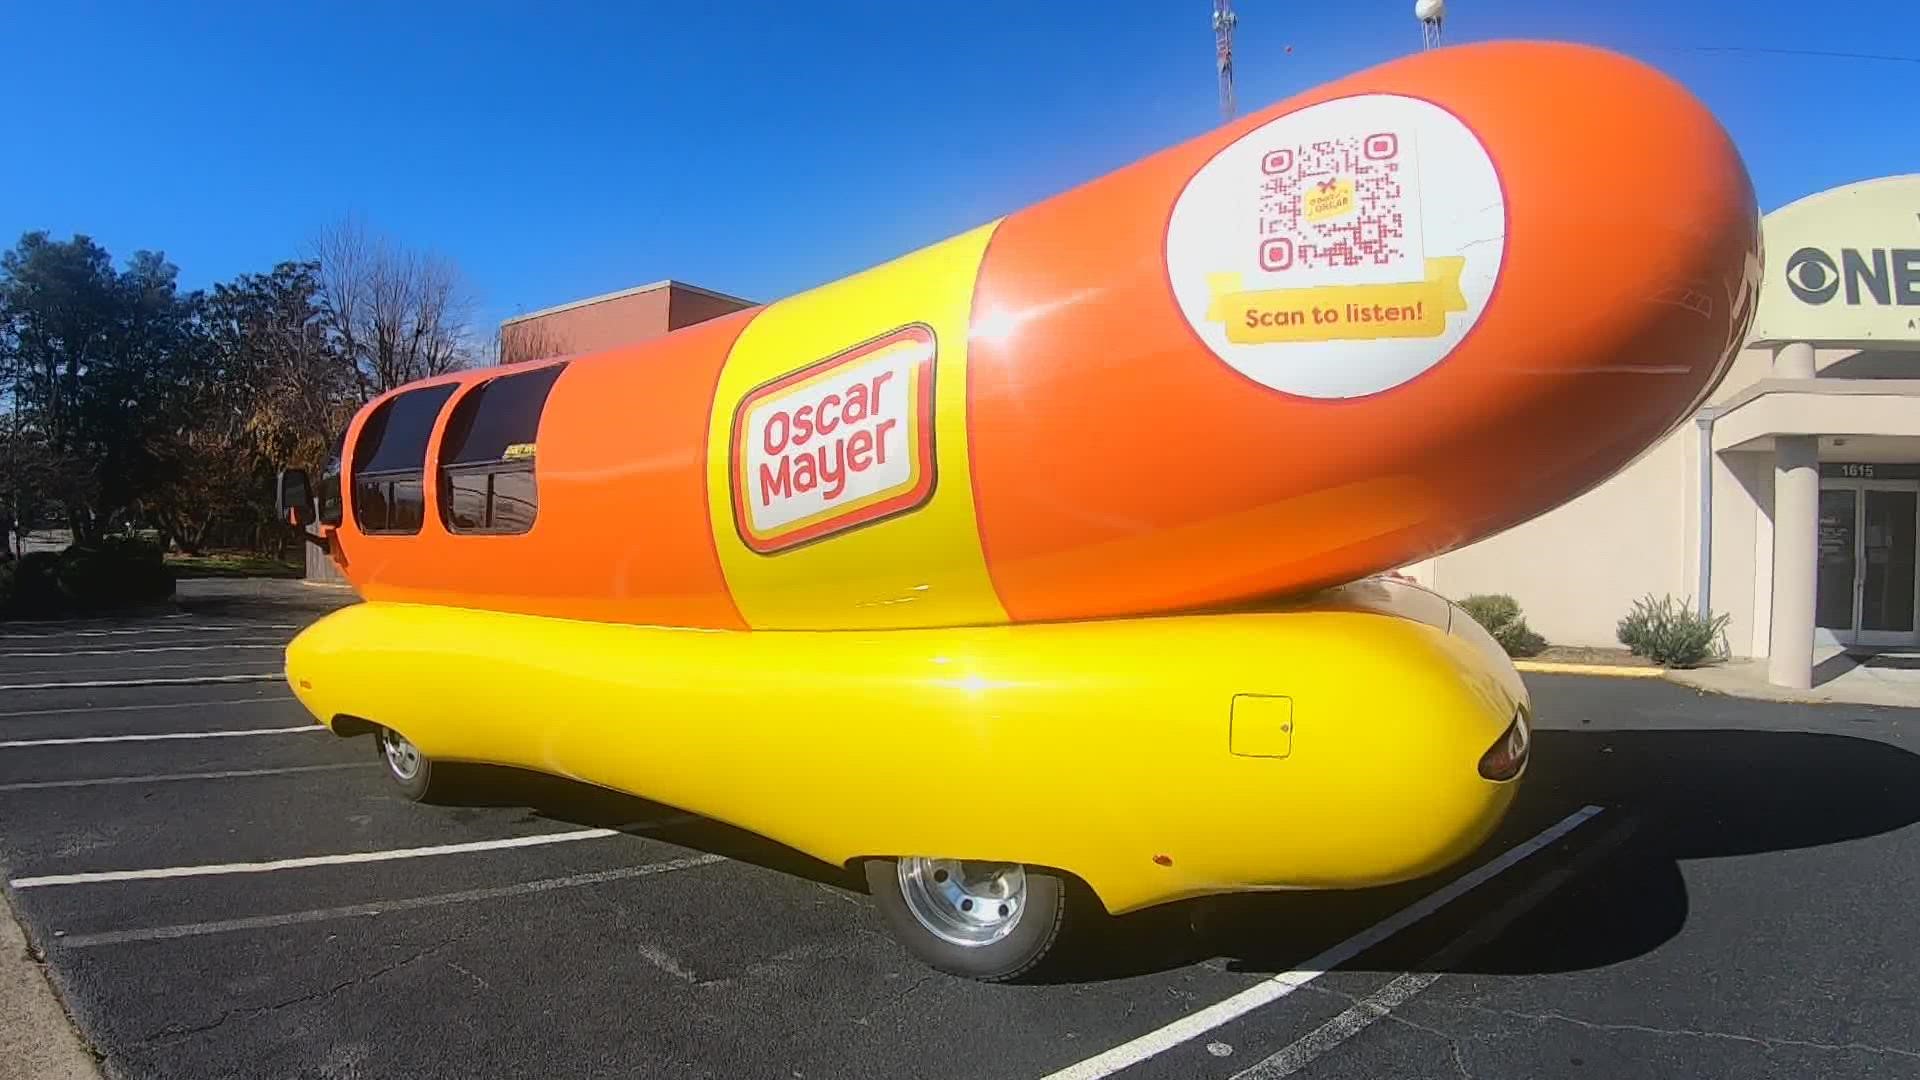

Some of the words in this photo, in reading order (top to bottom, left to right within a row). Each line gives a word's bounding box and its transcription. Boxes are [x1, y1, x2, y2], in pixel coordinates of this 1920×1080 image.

[1245, 309, 1305, 328] Scan
[1312, 306, 1339, 325] to
[1346, 302, 1424, 323] listen!
[763, 370, 894, 456] Oscar
[759, 418, 896, 507] Mayer
[1841, 464, 1874, 478] 1615
